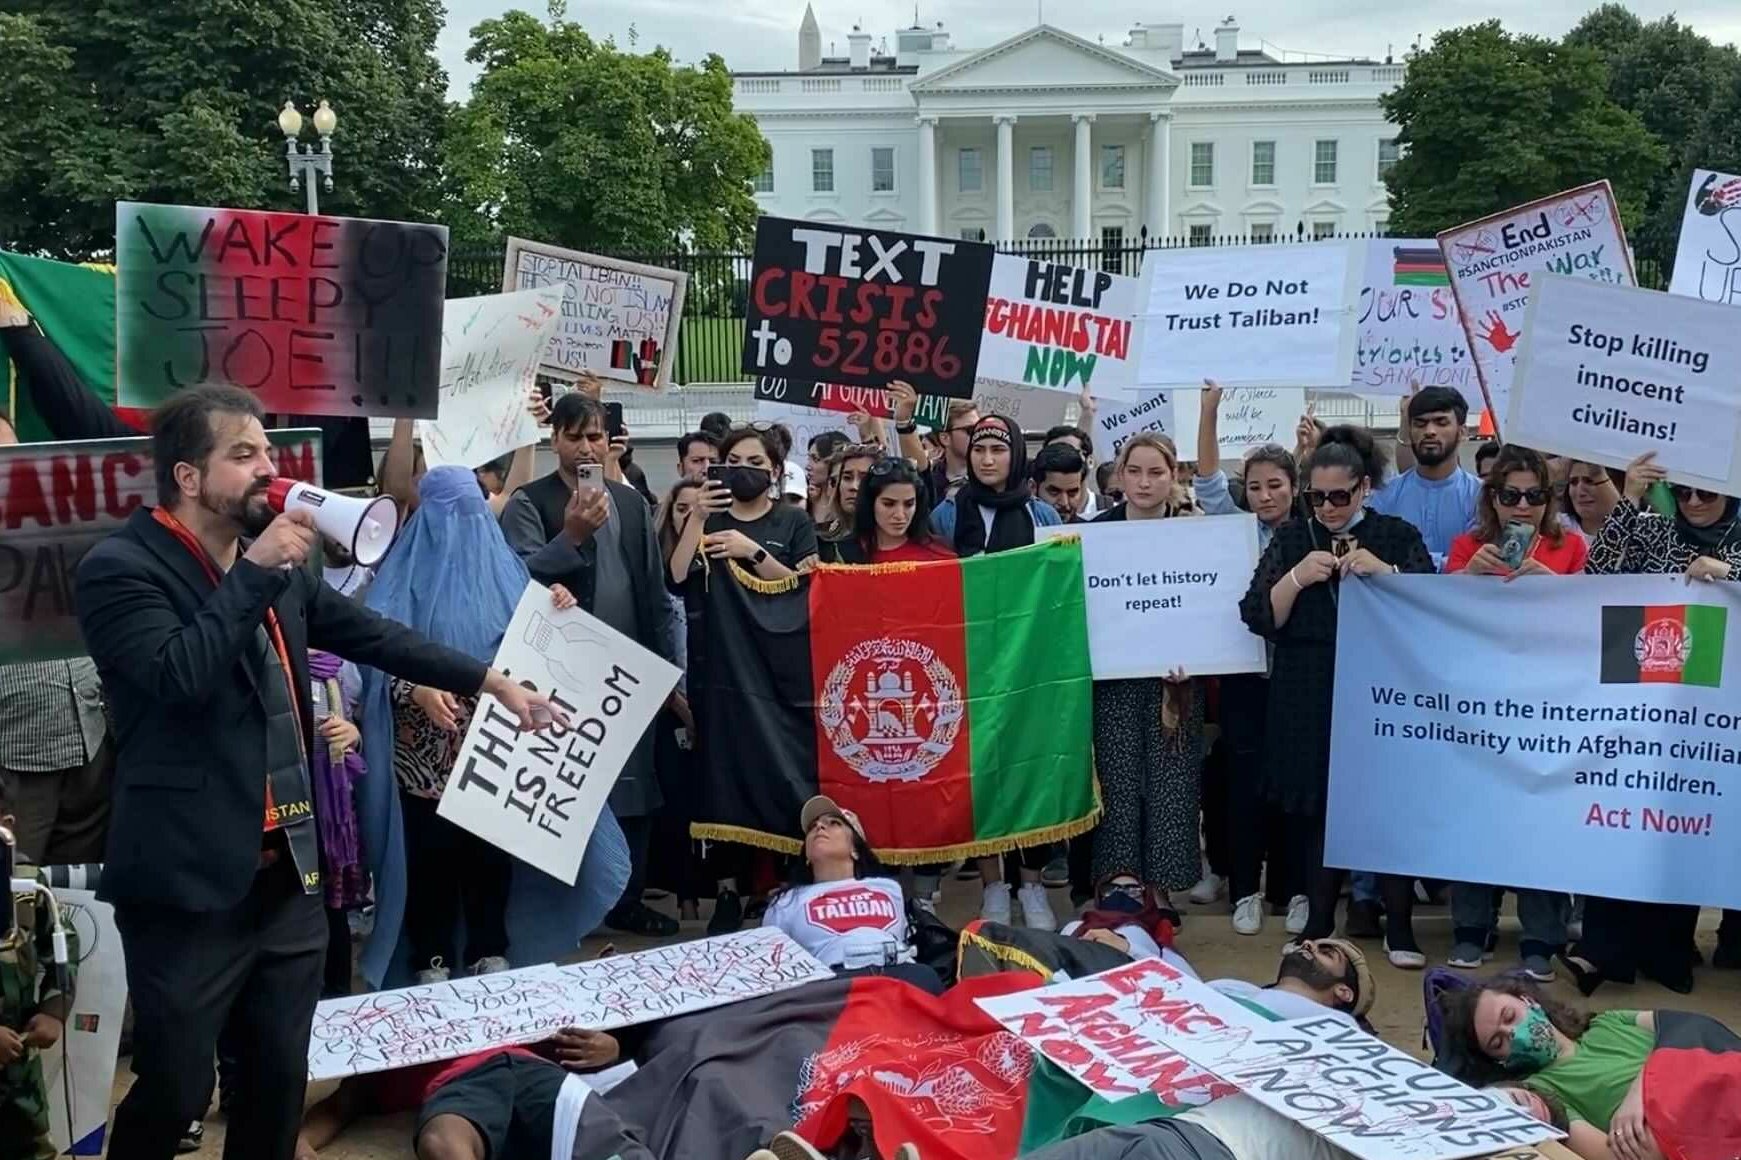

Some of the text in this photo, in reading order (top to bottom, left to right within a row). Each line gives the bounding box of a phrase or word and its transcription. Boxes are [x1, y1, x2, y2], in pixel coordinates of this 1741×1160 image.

[136, 213, 446, 279] WAKE UP
[1501, 212, 1551, 249] End
[792, 228, 956, 286] TEXT
[1458, 228, 1592, 279] #SANCTIONPAKISTAN
[140, 271, 390, 329] SLEEPY
[754, 267, 944, 332] CRISIS
[1025, 261, 1113, 309] HELP
[1184, 279, 1309, 301] We Do Not
[1477, 271, 1531, 298] The
[1166, 307, 1319, 332] Trust Taliban!
[752, 319, 962, 380] to 52886
[1022, 345, 1097, 389] NOW
[1568, 325, 1710, 374] Stop killing
[1577, 364, 1685, 404] innocent
[1101, 392, 1169, 432] We want
[1572, 404, 1677, 442] civilians!
[1088, 570, 1218, 588] Don't let history
[1125, 595, 1182, 613] repeat!
[1371, 686, 1407, 707] We
[1414, 688, 1449, 712] call
[1457, 697, 1486, 716] on
[1494, 696, 1535, 719] the
[1542, 701, 1697, 727] international
[537, 663, 640, 838] FREEDOM
[1373, 718, 1396, 737] in
[1402, 719, 1512, 755] solidarity
[1518, 734, 1571, 755] with
[1576, 735, 1662, 760] Afghan
[504, 766, 547, 823] IS
[1574, 767, 1723, 797] and children.
[1585, 804, 1713, 837] Act Now!
[812, 900, 895, 921] TALIBAN
[1254, 1038, 1506, 1148] AFGHANS
[1293, 1017, 1545, 1143] EVACUATE
[1236, 1068, 1398, 1138] NOW
